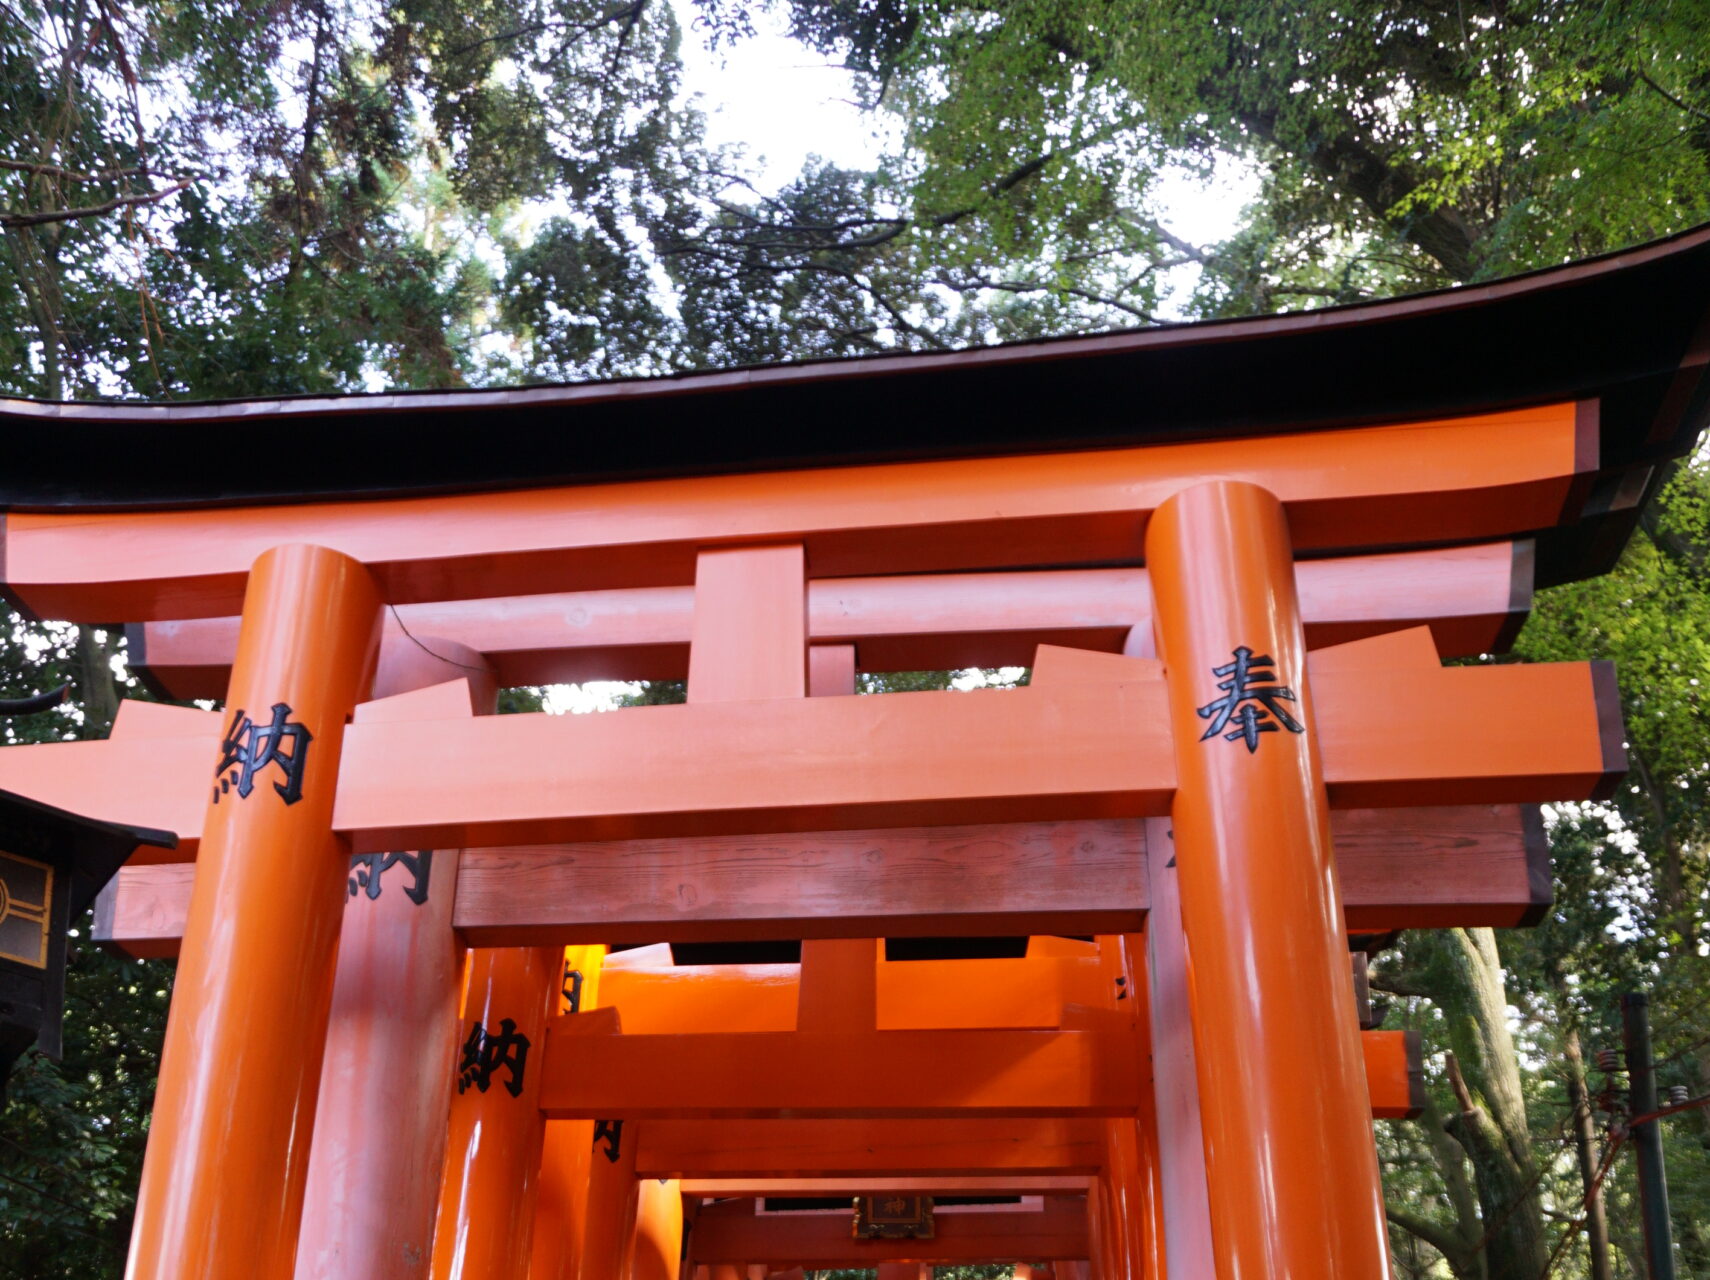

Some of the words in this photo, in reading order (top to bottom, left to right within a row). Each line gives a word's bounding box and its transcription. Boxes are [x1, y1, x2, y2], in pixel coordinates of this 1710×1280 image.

[1196, 645, 1305, 755] 奉
[213, 702, 314, 806] 納
[458, 1017, 531, 1098] 納
